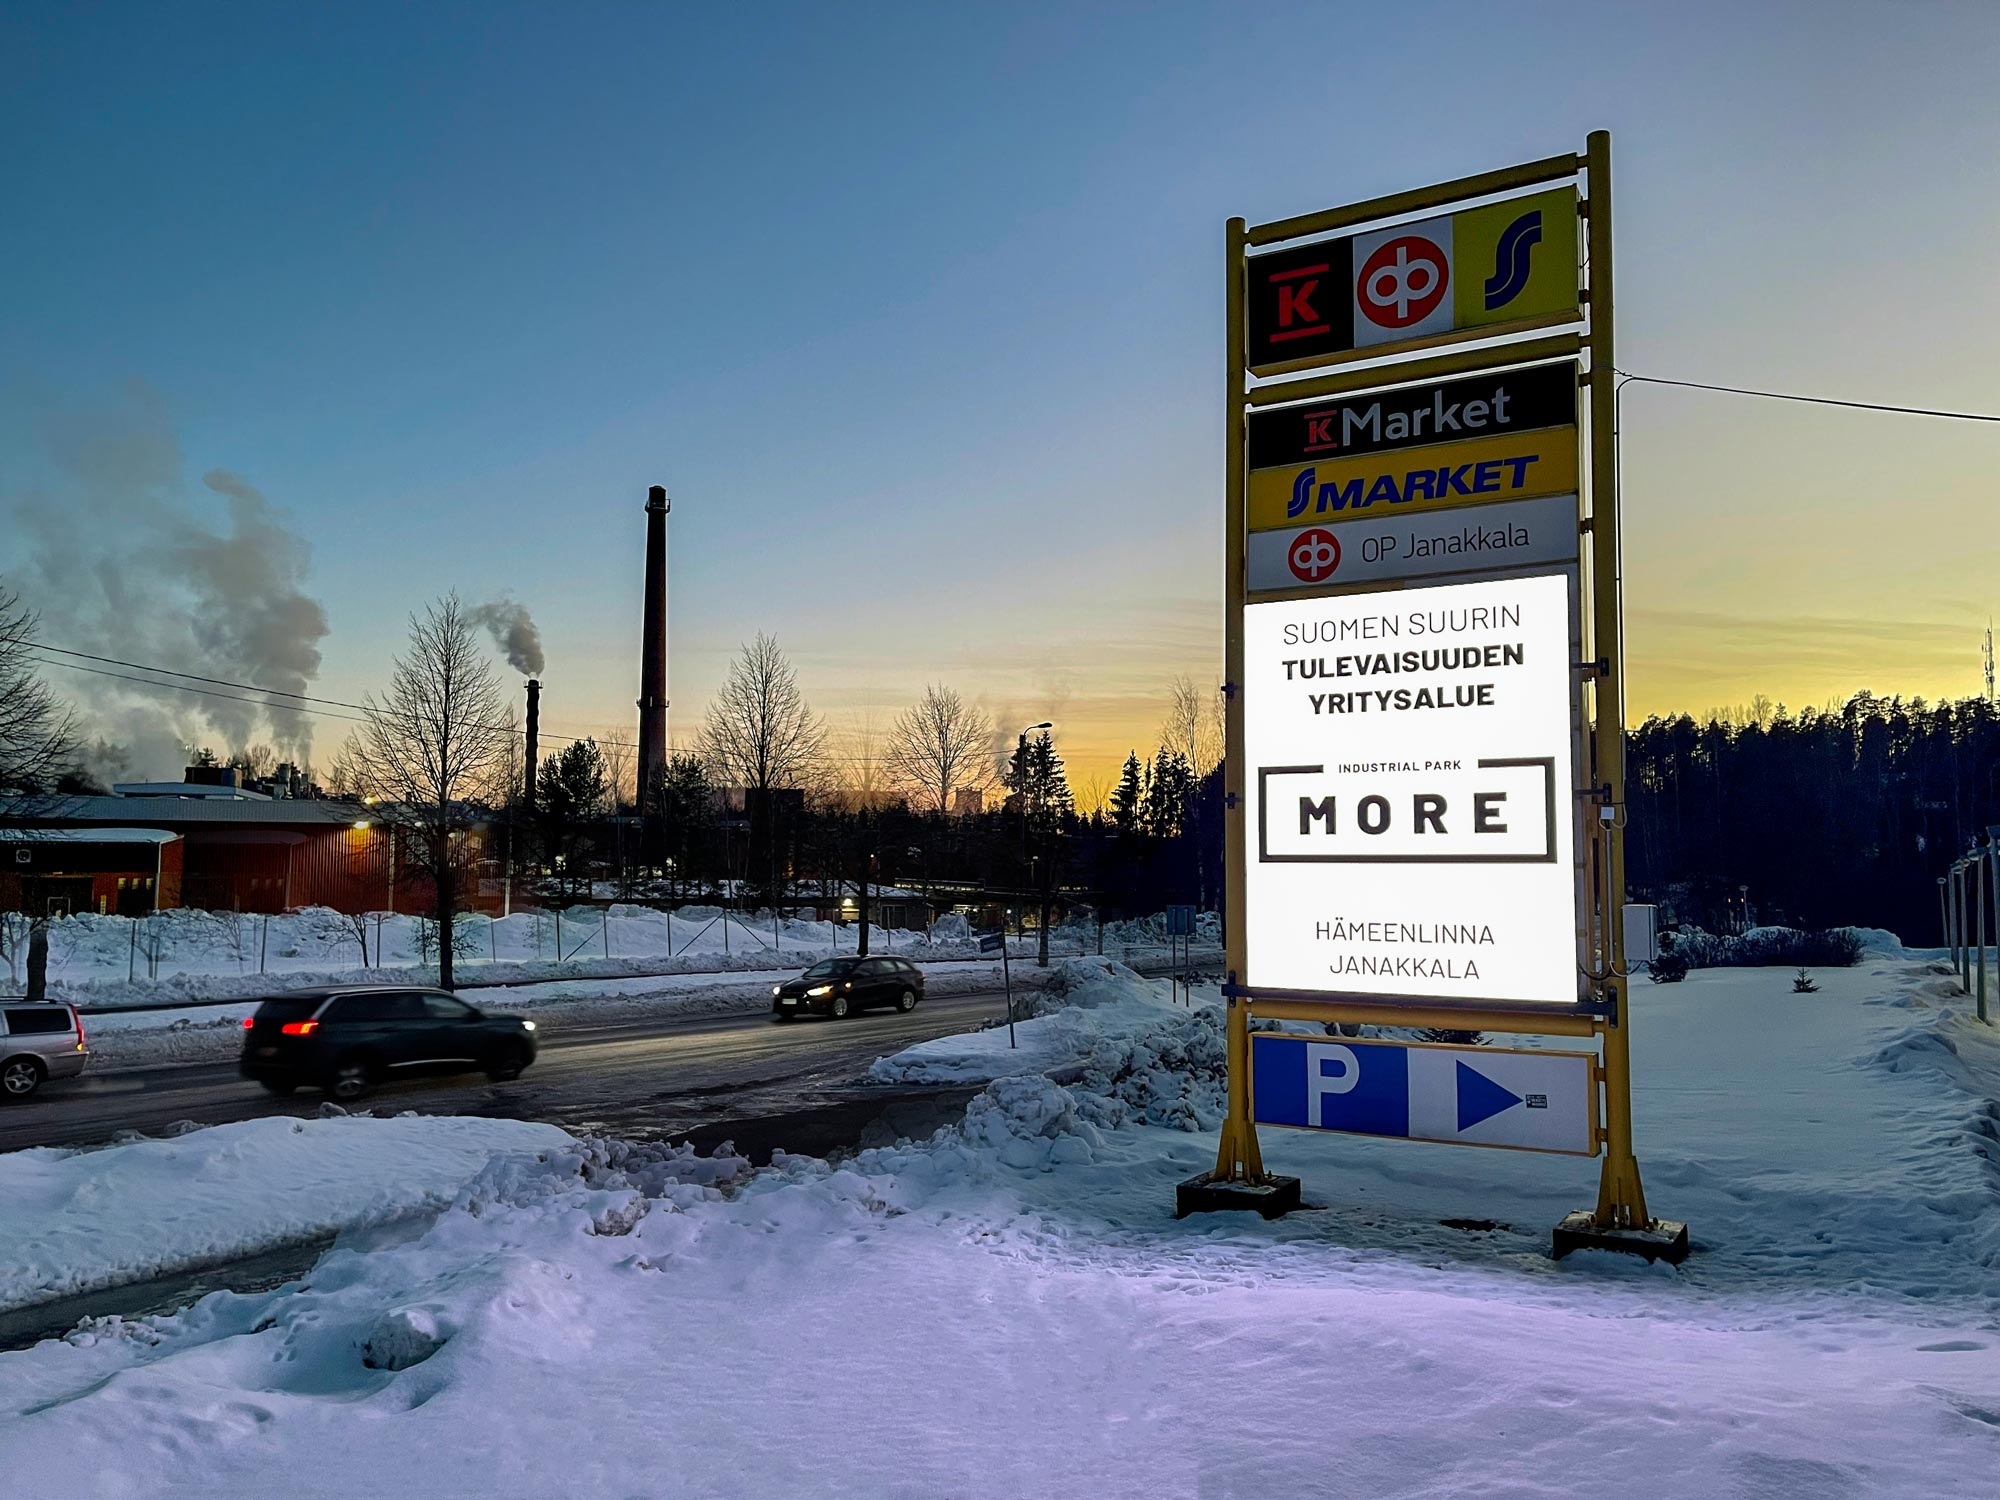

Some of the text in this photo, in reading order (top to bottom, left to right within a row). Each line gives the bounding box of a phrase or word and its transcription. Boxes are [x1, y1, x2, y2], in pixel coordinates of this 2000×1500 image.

[1279, 280, 1320, 327] K
[1309, 386, 1511, 447] K Market
[1361, 522, 1531, 564] OP Janakkala
[1283, 604, 1521, 645] SUOMEN SUURIN
[1282, 643, 1524, 680] TULEVAISUUDEN
[1308, 684, 1495, 715] YRITYSALUE
[1338, 760, 1462, 774] INDUSTRIAL PARK
[1299, 792, 1508, 835] MORE
[1315, 917, 1495, 945] HÄMEENLINNA
[1329, 955, 1480, 980] JANAKKALA
[1306, 1042, 1360, 1127] P
